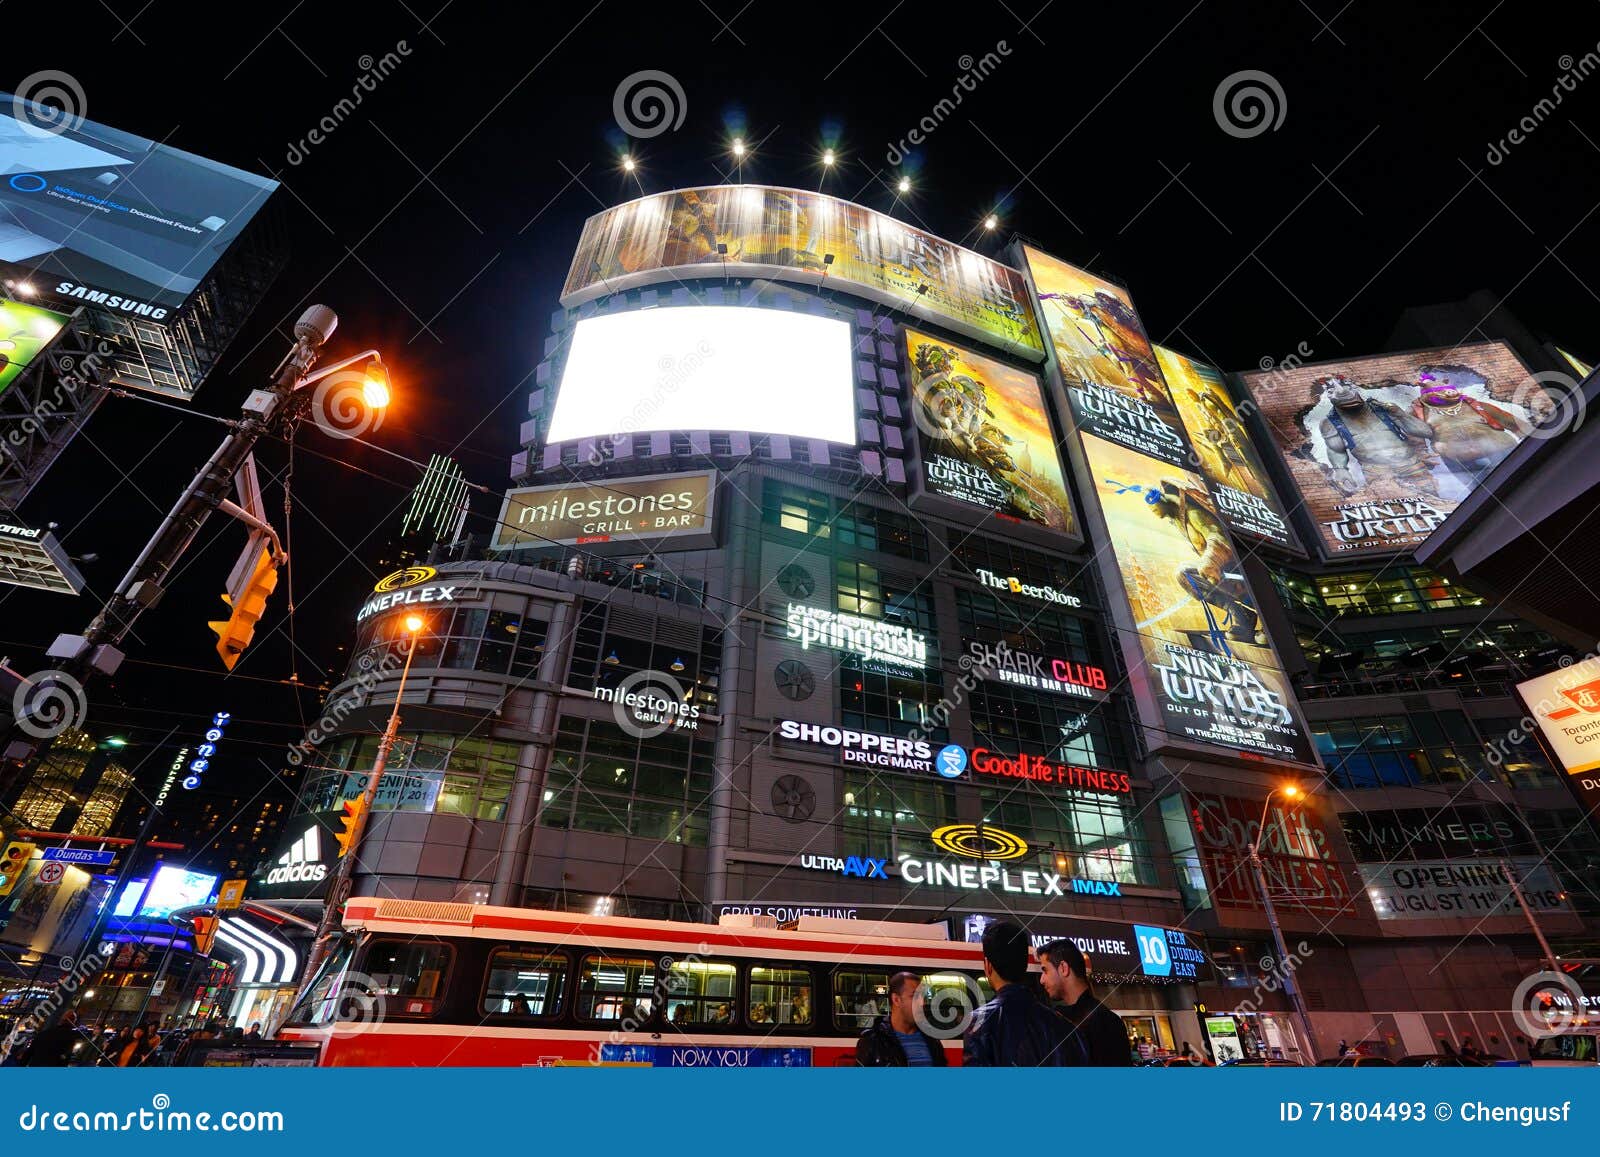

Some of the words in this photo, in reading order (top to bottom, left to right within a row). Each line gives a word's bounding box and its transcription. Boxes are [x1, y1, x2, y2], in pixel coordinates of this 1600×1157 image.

[129, 208, 174, 226] Document
[174, 221, 204, 235] Feeder
[55, 281, 169, 320] SAMSUNG
[1085, 383, 1157, 419] NINJA
[1071, 387, 1184, 447] TURTLES
[924, 461, 1005, 499] TURTLES
[937, 457, 990, 481] NINJA
[518, 491, 693, 524] milestones
[1211, 491, 1286, 530] TURTLES
[1220, 488, 1267, 511] NINJA
[583, 520, 633, 534] GRILL
[655, 514, 691, 528] BAR
[1341, 502, 1446, 522] NINJA
[1338, 543, 1361, 551] OUT
[1364, 540, 1380, 548] OF
[1385, 537, 1409, 545] THE
[356, 586, 457, 623] CINEPLEX
[1164, 643, 1208, 659] TEENAGE
[970, 642, 1046, 678] SHARK
[1052, 659, 1107, 690] CLUB
[1170, 651, 1263, 692] NINJA
[999, 669, 1038, 687] SPORTS
[1041, 678, 1062, 691] BAR
[1065, 682, 1093, 698] GRILL
[1152, 663, 1294, 726] TURTLES
[594, 686, 700, 718] milestones
[634, 711, 665, 725] GRILL
[676, 719, 698, 730] BAR
[1167, 703, 1190, 715] OUT
[1193, 708, 1209, 718] OF
[1213, 711, 1237, 724] THE
[1240, 717, 1298, 737] SHADOWS
[1209, 722, 1236, 736] JUNE
[779, 719, 932, 760] SHOPPERS
[1185, 726, 1195, 736] IN
[1195, 728, 1238, 743] THEATRES
[1238, 737, 1256, 747] AND
[844, 749, 889, 767] DRUG
[891, 755, 932, 772] MART
[971, 746, 1053, 782] GoodLife
[1057, 764, 1131, 793] FITNESS
[155, 747, 190, 806] DOWNTOWN
[357, 775, 423, 789] OENING
[1359, 821, 1514, 845] WINNERS
[55, 849, 94, 861] Dundas
[267, 862, 327, 885] adidas
[898, 854, 1065, 897] CINEPLEX
[1072, 879, 1123, 897] IMAX
[1097, 939, 1130, 956] HERE.
[1167, 929, 1186, 945] TEN
[1140, 935, 1167, 965] 10
[1170, 945, 1205, 964] DUNDAS
[1174, 962, 1198, 978] EAST
[671, 1049, 712, 1067] NOW
[717, 1049, 748, 1067] YOU
